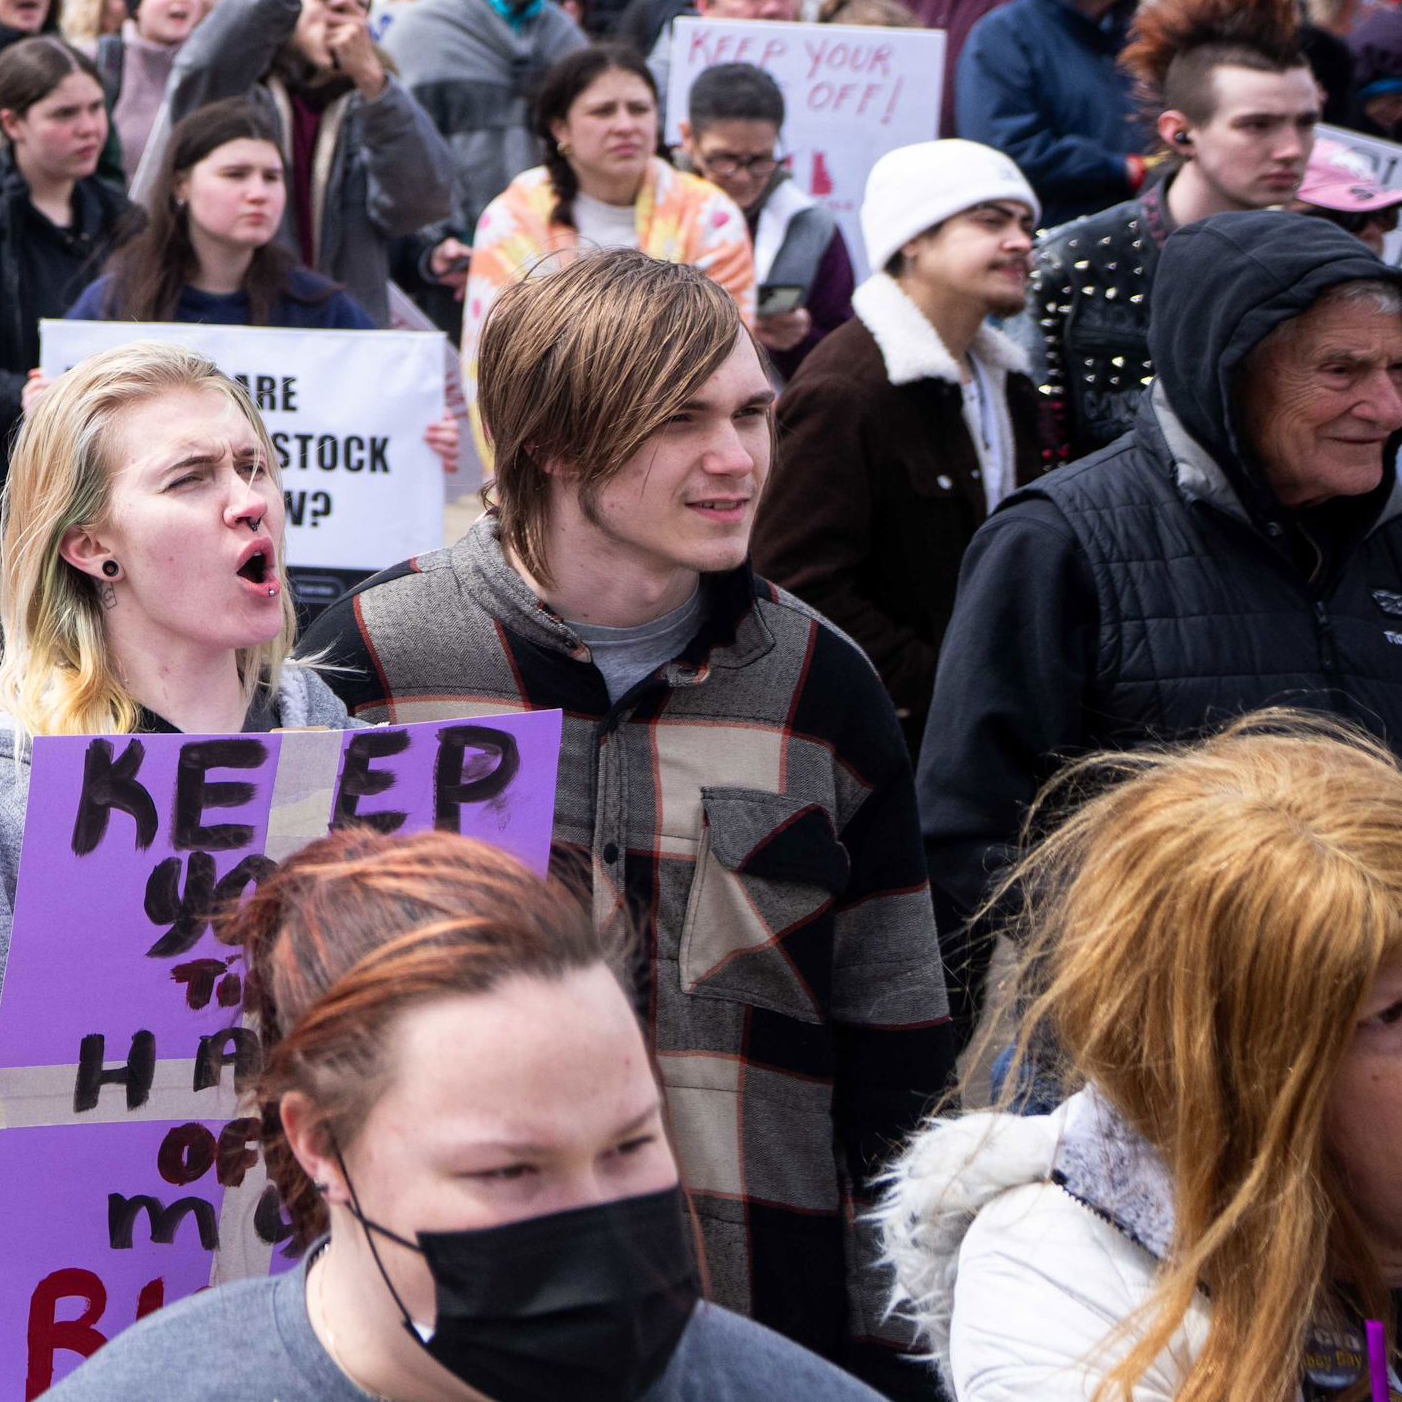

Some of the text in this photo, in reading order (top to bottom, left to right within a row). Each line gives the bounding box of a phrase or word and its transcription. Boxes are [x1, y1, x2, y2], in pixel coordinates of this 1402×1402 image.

[804, 39, 893, 78] YOUR
[806, 76, 905, 126] OFF!
[70, 725, 522, 856] KEEP
